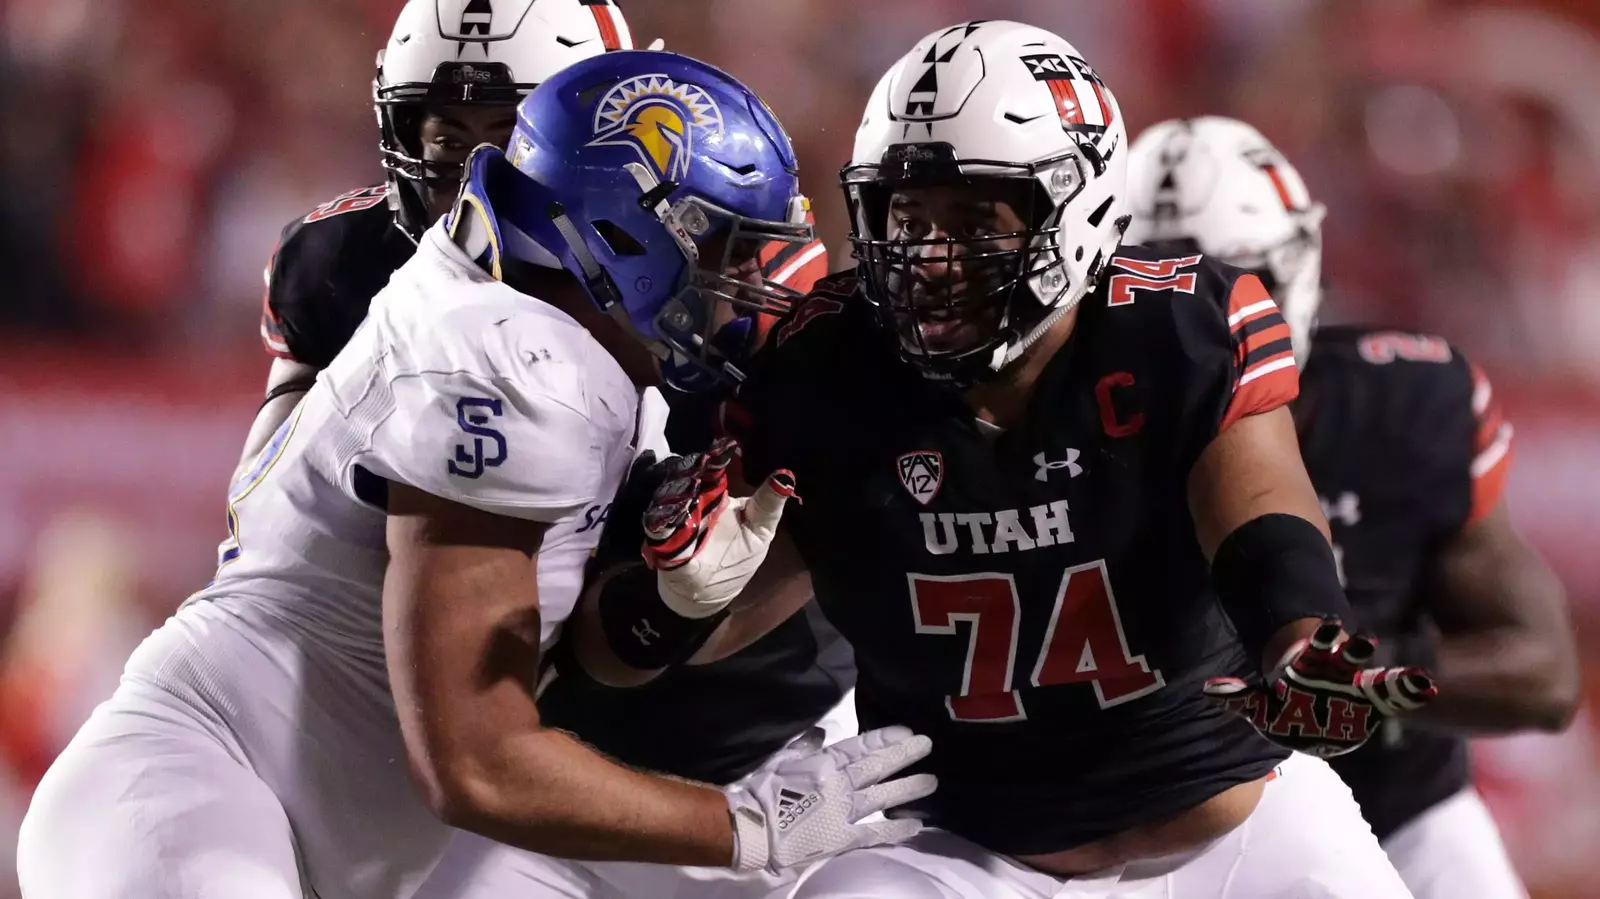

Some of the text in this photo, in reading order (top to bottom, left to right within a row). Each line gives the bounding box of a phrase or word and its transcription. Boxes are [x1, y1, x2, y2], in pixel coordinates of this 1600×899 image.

[1108, 254, 1203, 307] 74
[1095, 371, 1145, 437] C
[911, 474, 935, 495] 12
[919, 500, 1075, 555] UTAH
[906, 559, 1166, 724] 74
[779, 793, 819, 829] adidas
